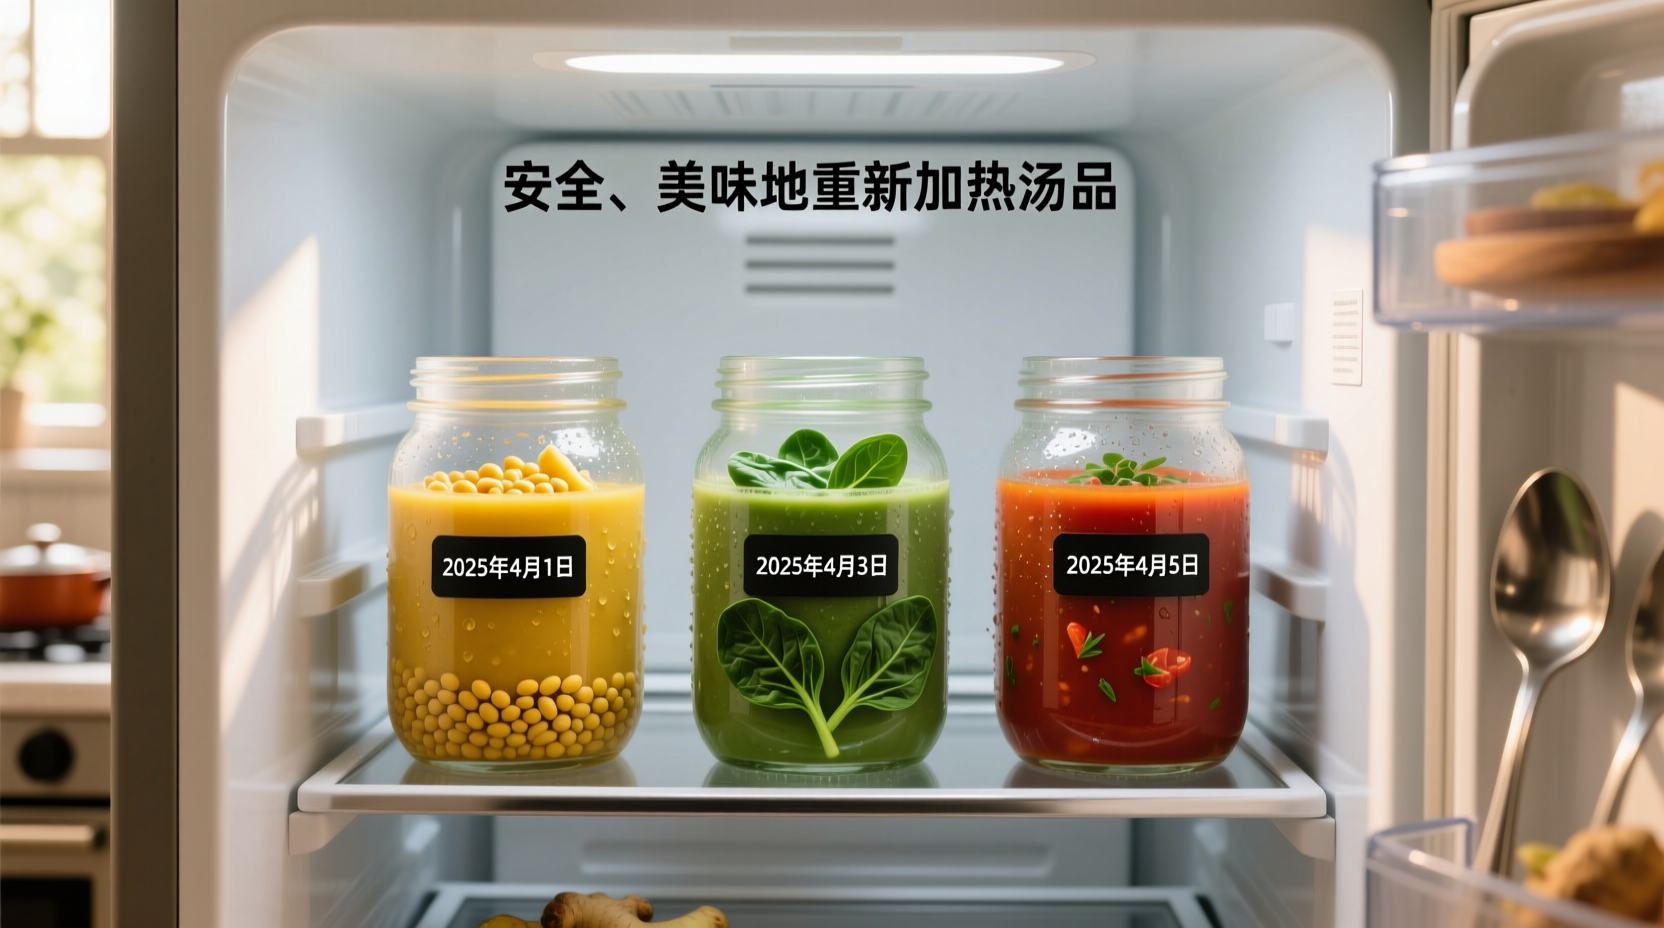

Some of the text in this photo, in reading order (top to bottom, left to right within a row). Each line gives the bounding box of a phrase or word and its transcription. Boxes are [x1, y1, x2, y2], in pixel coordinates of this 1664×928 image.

[442, 555, 573, 580] 2025年4月1日
[756, 554, 887, 578] 2025年4月3日
[1066, 553, 1198, 578] 2025年4月5日
